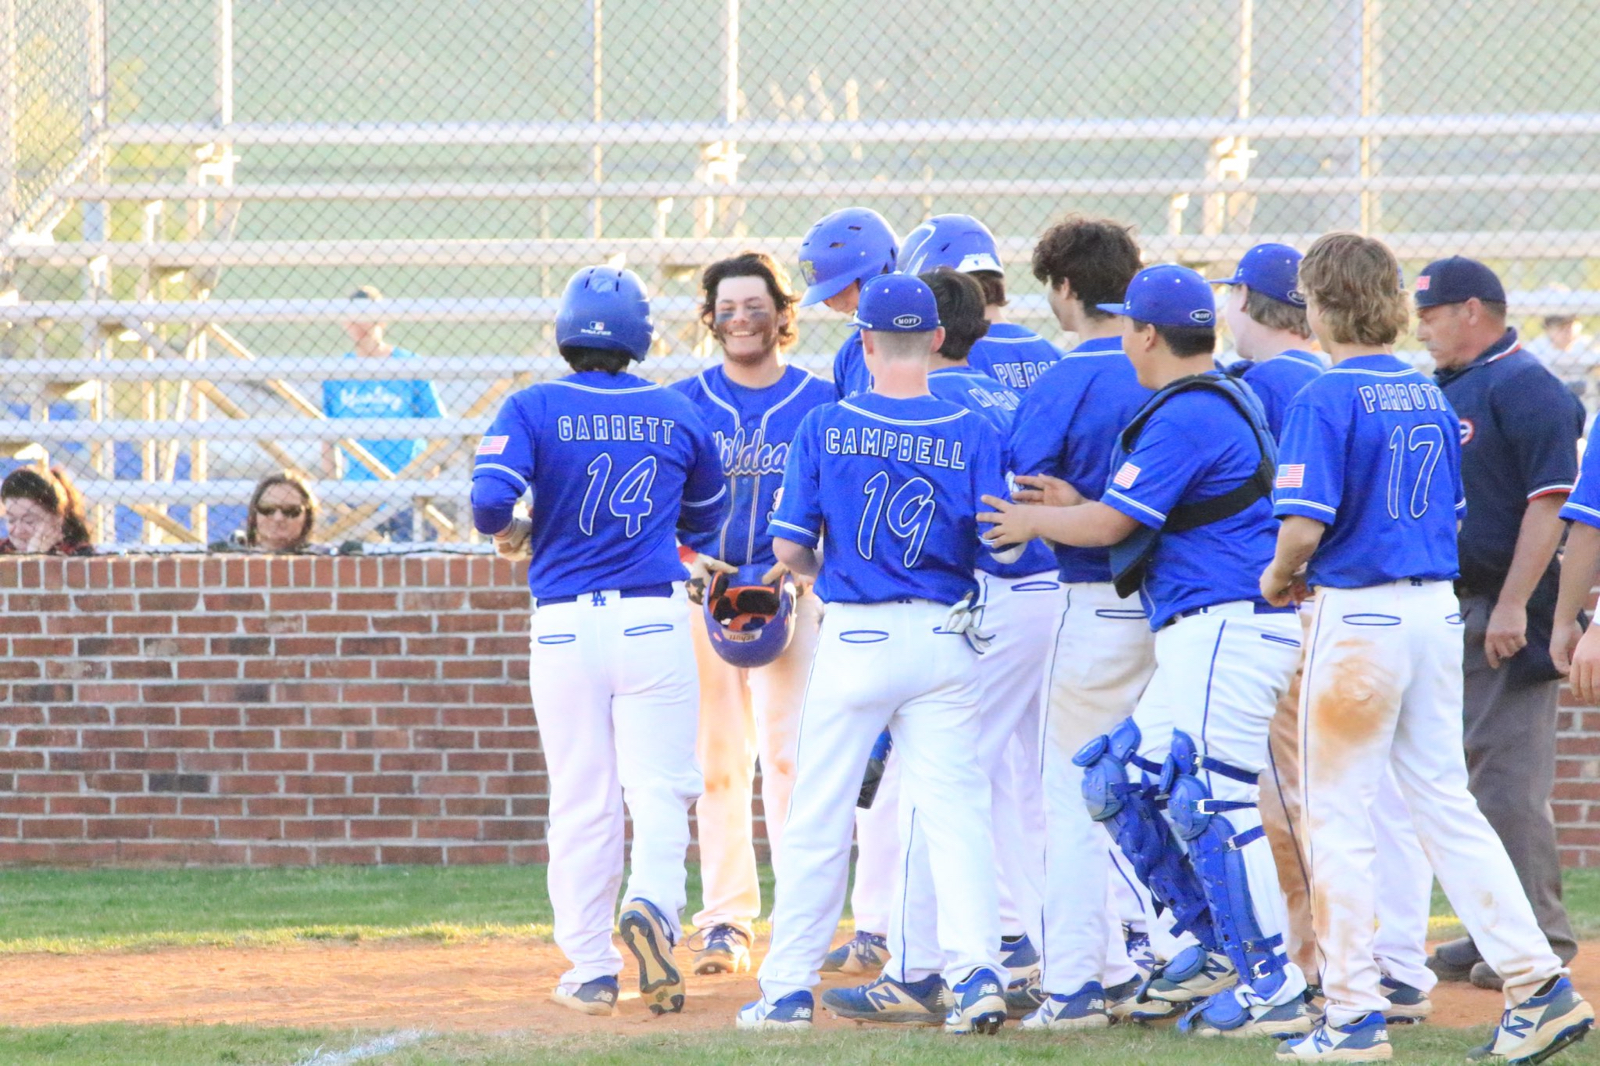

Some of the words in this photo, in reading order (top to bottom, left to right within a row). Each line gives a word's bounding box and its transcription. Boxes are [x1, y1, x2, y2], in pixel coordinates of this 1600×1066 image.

[1358, 383, 1447, 413] PARROTT
[557, 414, 675, 445] GARRETT
[825, 427, 966, 470] CAMPBELL
[1387, 423, 1445, 520] 17
[578, 452, 657, 539] 14
[857, 470, 936, 569] 19
[868, 985, 902, 1011] N
[1504, 1015, 1535, 1039] N
